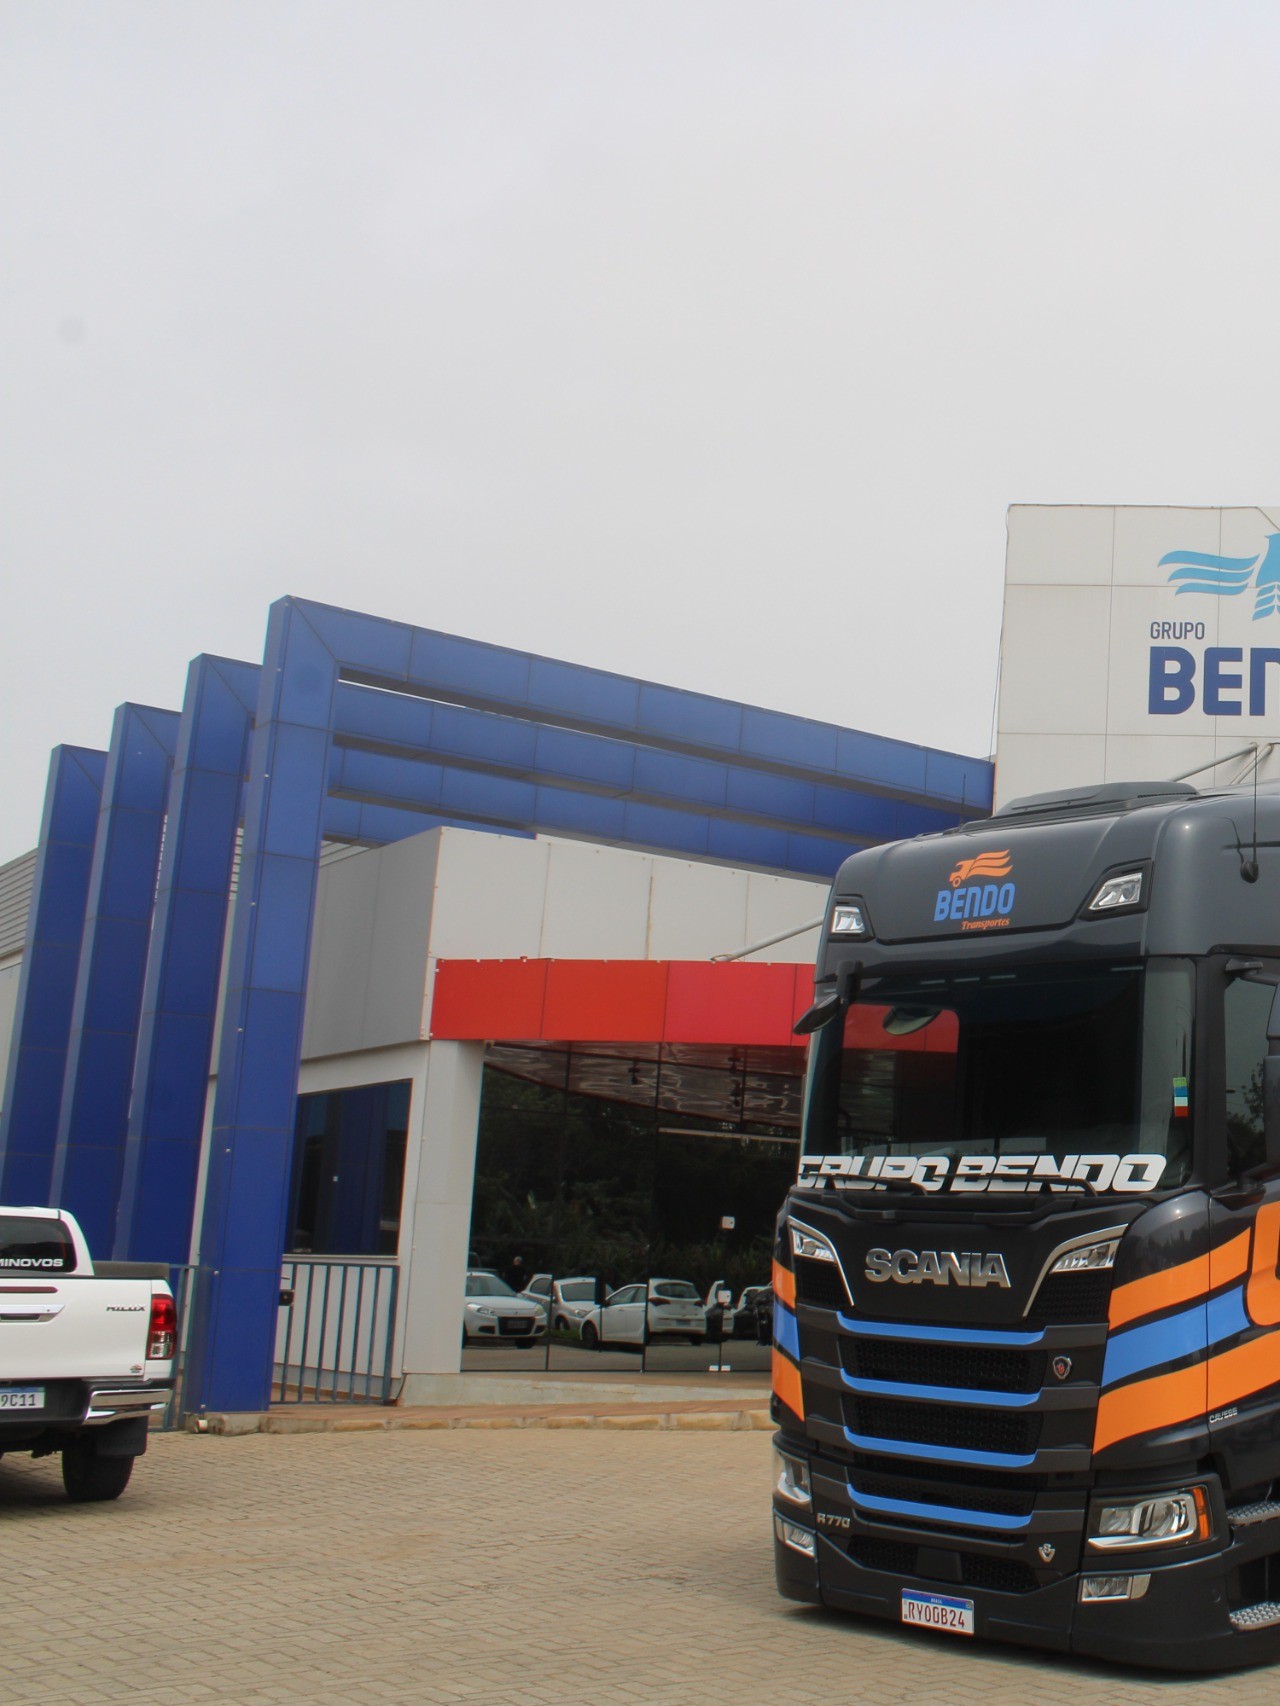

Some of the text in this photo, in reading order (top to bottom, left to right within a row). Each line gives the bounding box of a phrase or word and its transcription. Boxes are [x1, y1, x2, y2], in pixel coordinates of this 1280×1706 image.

[1150, 621, 1205, 640] GRUPO
[933, 882, 1016, 922] BENDO
[961, 918, 1011, 931] Transportes
[797, 1153, 1167, 1193] GRUPO BENDO
[864, 1247, 1012, 1289] SCANIA
